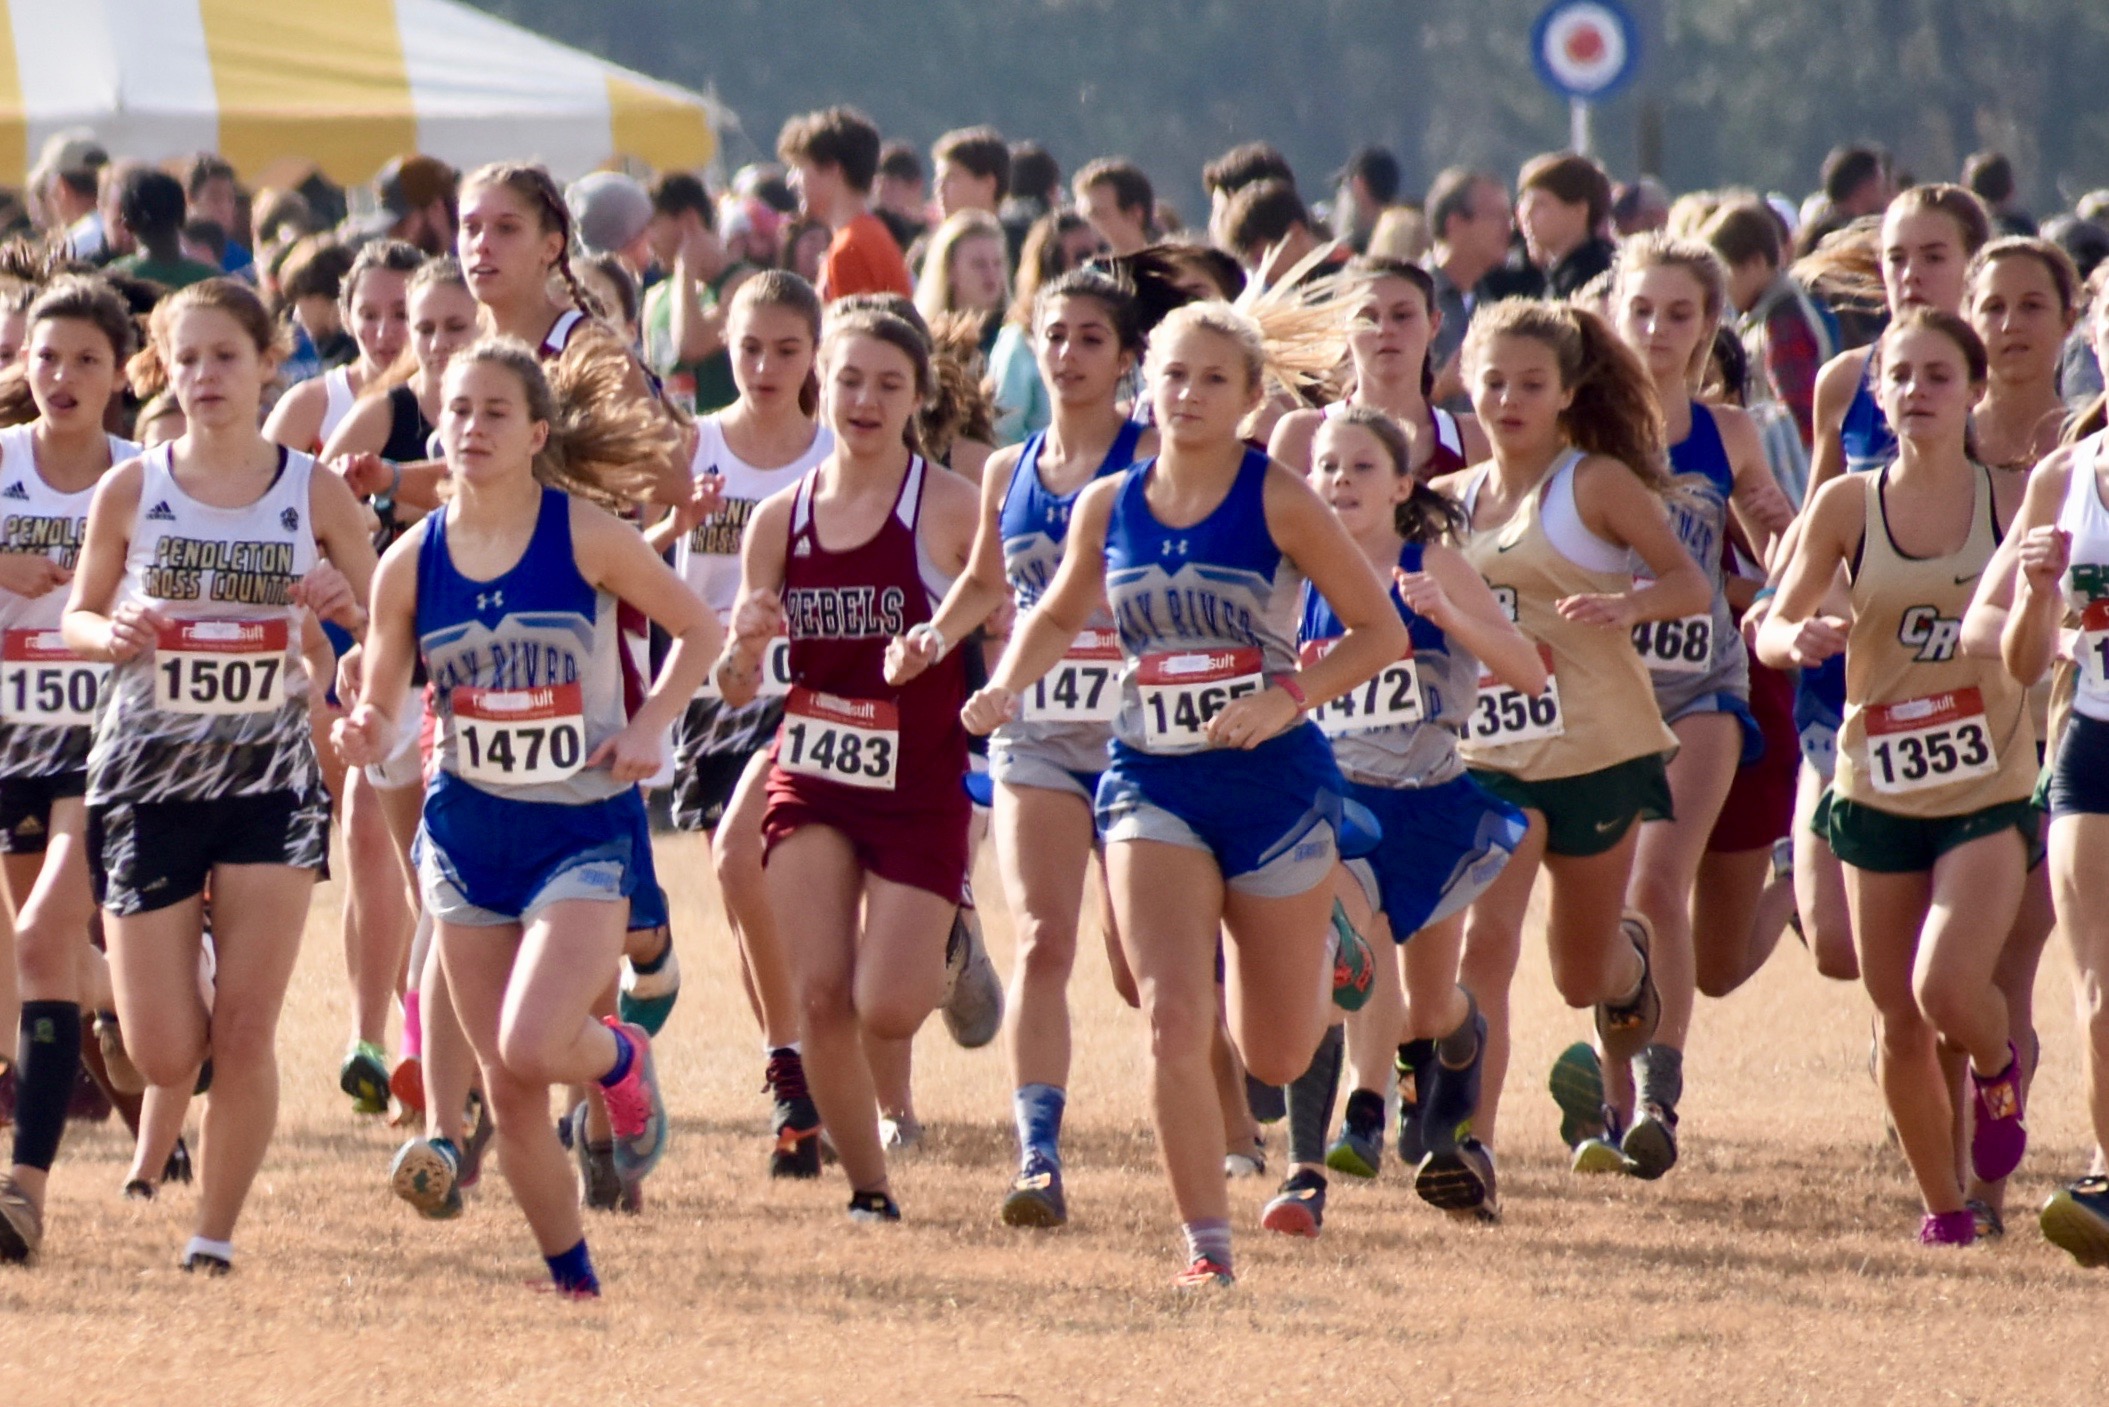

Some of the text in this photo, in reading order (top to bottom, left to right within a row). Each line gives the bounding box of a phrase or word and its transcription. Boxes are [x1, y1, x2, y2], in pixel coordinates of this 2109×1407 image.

[5, 515, 87, 546] PENDLE
[154, 535, 294, 573] PENDLETON
[142, 565, 201, 600] CROSS
[1631, 617, 1710, 663] 468
[9, 667, 110, 714] 150
[161, 657, 280, 704] 1507
[1035, 667, 1118, 710] 147
[461, 723, 580, 773] 1470
[788, 722, 892, 778] 1483
[1874, 724, 1990, 784] 1353
